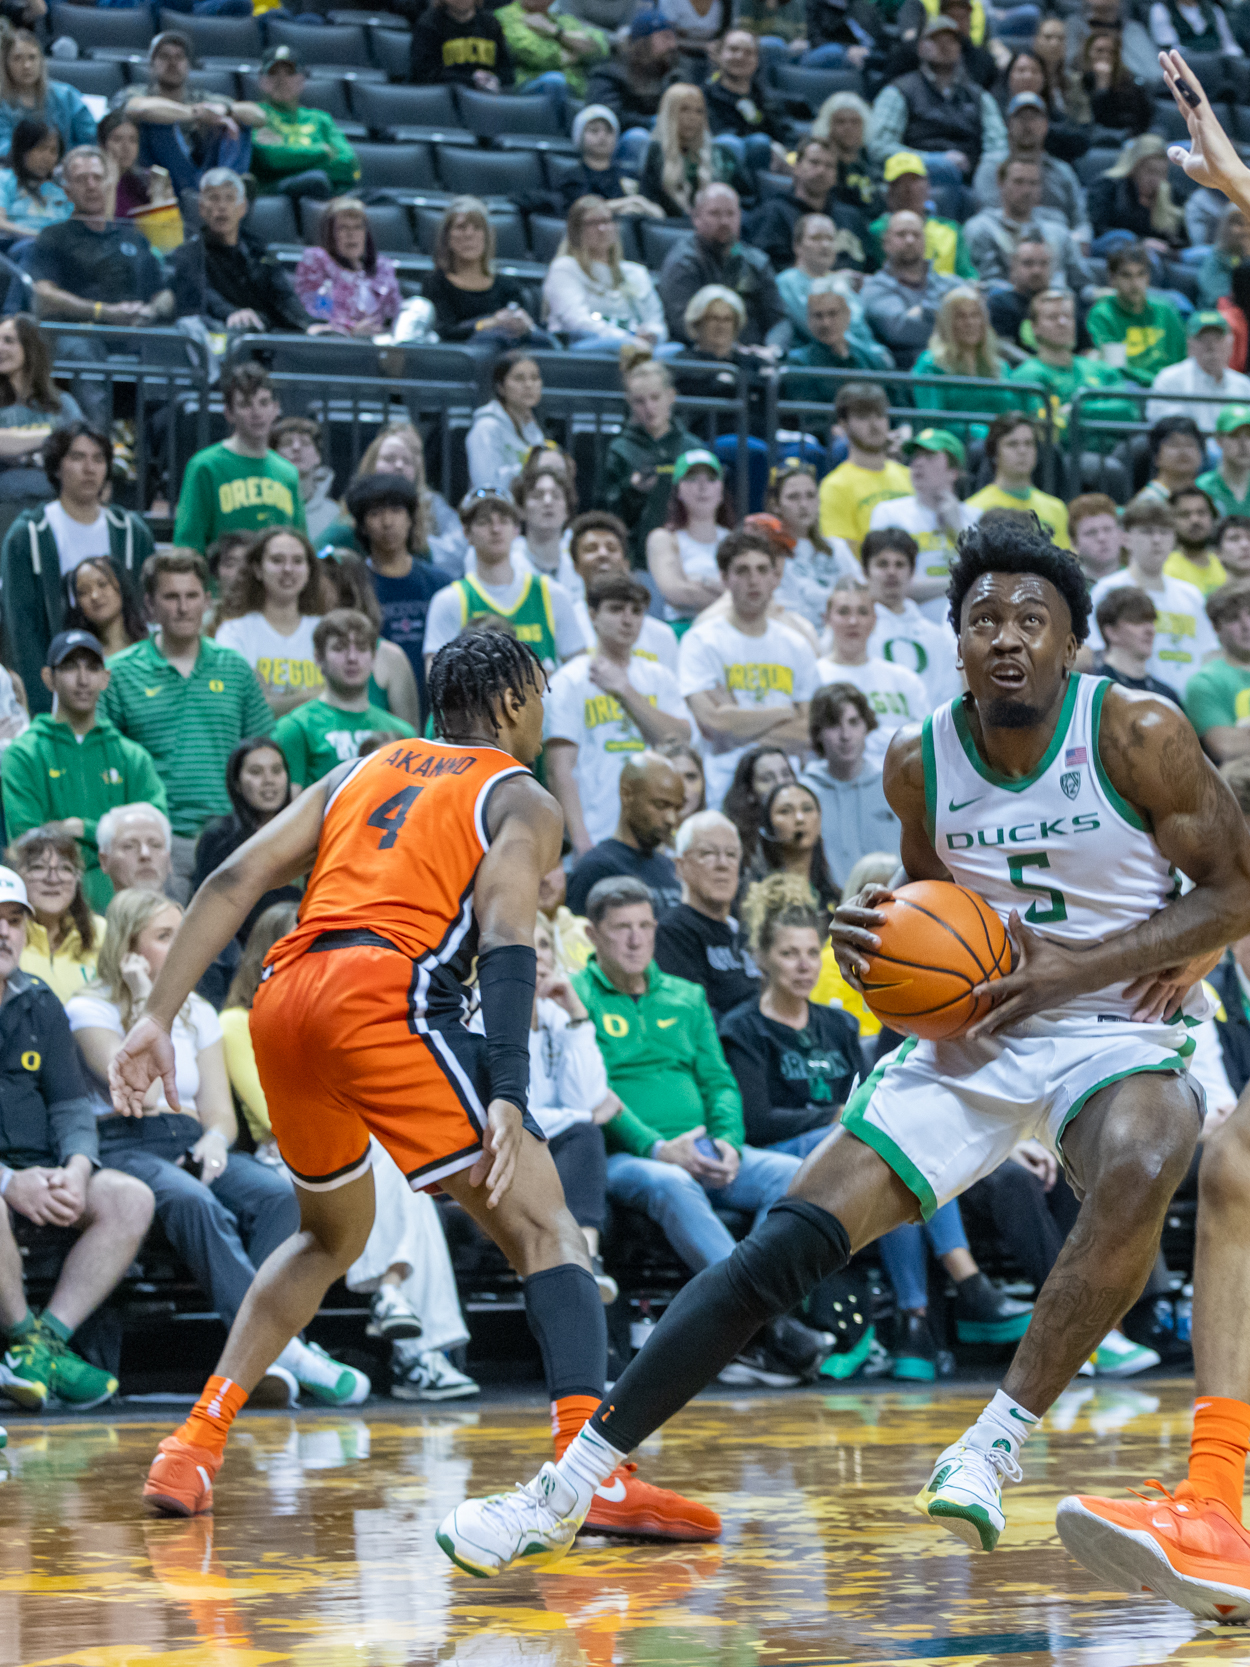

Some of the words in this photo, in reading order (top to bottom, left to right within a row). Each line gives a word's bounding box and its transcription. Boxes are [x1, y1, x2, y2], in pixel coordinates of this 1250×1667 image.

[219, 476, 294, 517] OREGON
[366, 785, 425, 851] 4
[945, 811, 1101, 850] DUCKS
[1006, 851, 1069, 924] 5
[602, 1012, 630, 1038] O
[21, 1050, 41, 1071] O
